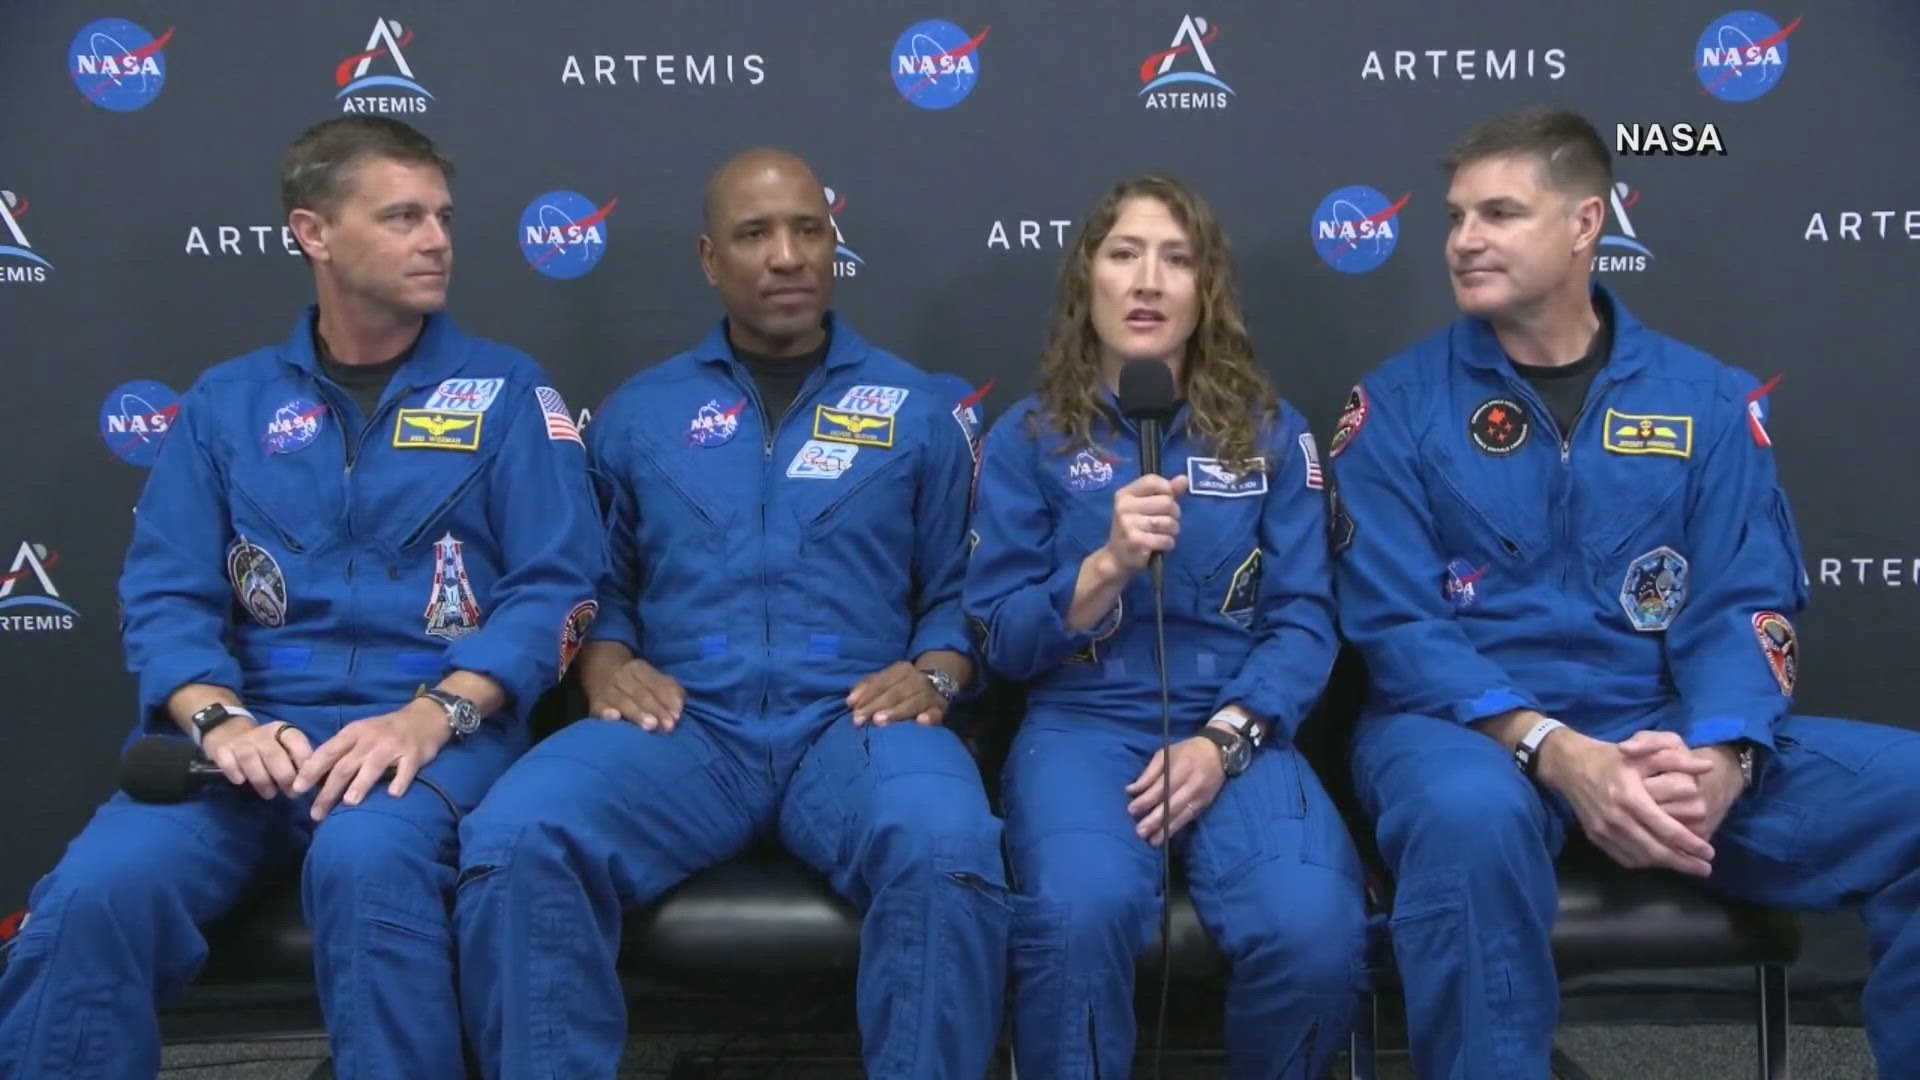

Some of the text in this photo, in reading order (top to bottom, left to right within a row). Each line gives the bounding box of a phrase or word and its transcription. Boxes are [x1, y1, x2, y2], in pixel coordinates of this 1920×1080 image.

[77, 54, 161, 75] NASA
[898, 54, 975, 74] NASA
[1361, 48, 1566, 81] ARTEMIS
[1702, 46, 1782, 66] NASA
[561, 54, 765, 85] ARTEMIS
[343, 97, 427, 113] ARTEMIS
[1145, 92, 1228, 109] ARTEMIS
[526, 225, 602, 244] NASA
[987, 220, 1072, 250] ART
[1319, 220, 1394, 239] NASA
[107, 415, 174, 433] NAS
[268, 416, 317, 434] NASA
[691, 414, 737, 430] NASA
[1070, 463, 1113, 478] NASA
[1803, 558, 1920, 586] RTE
